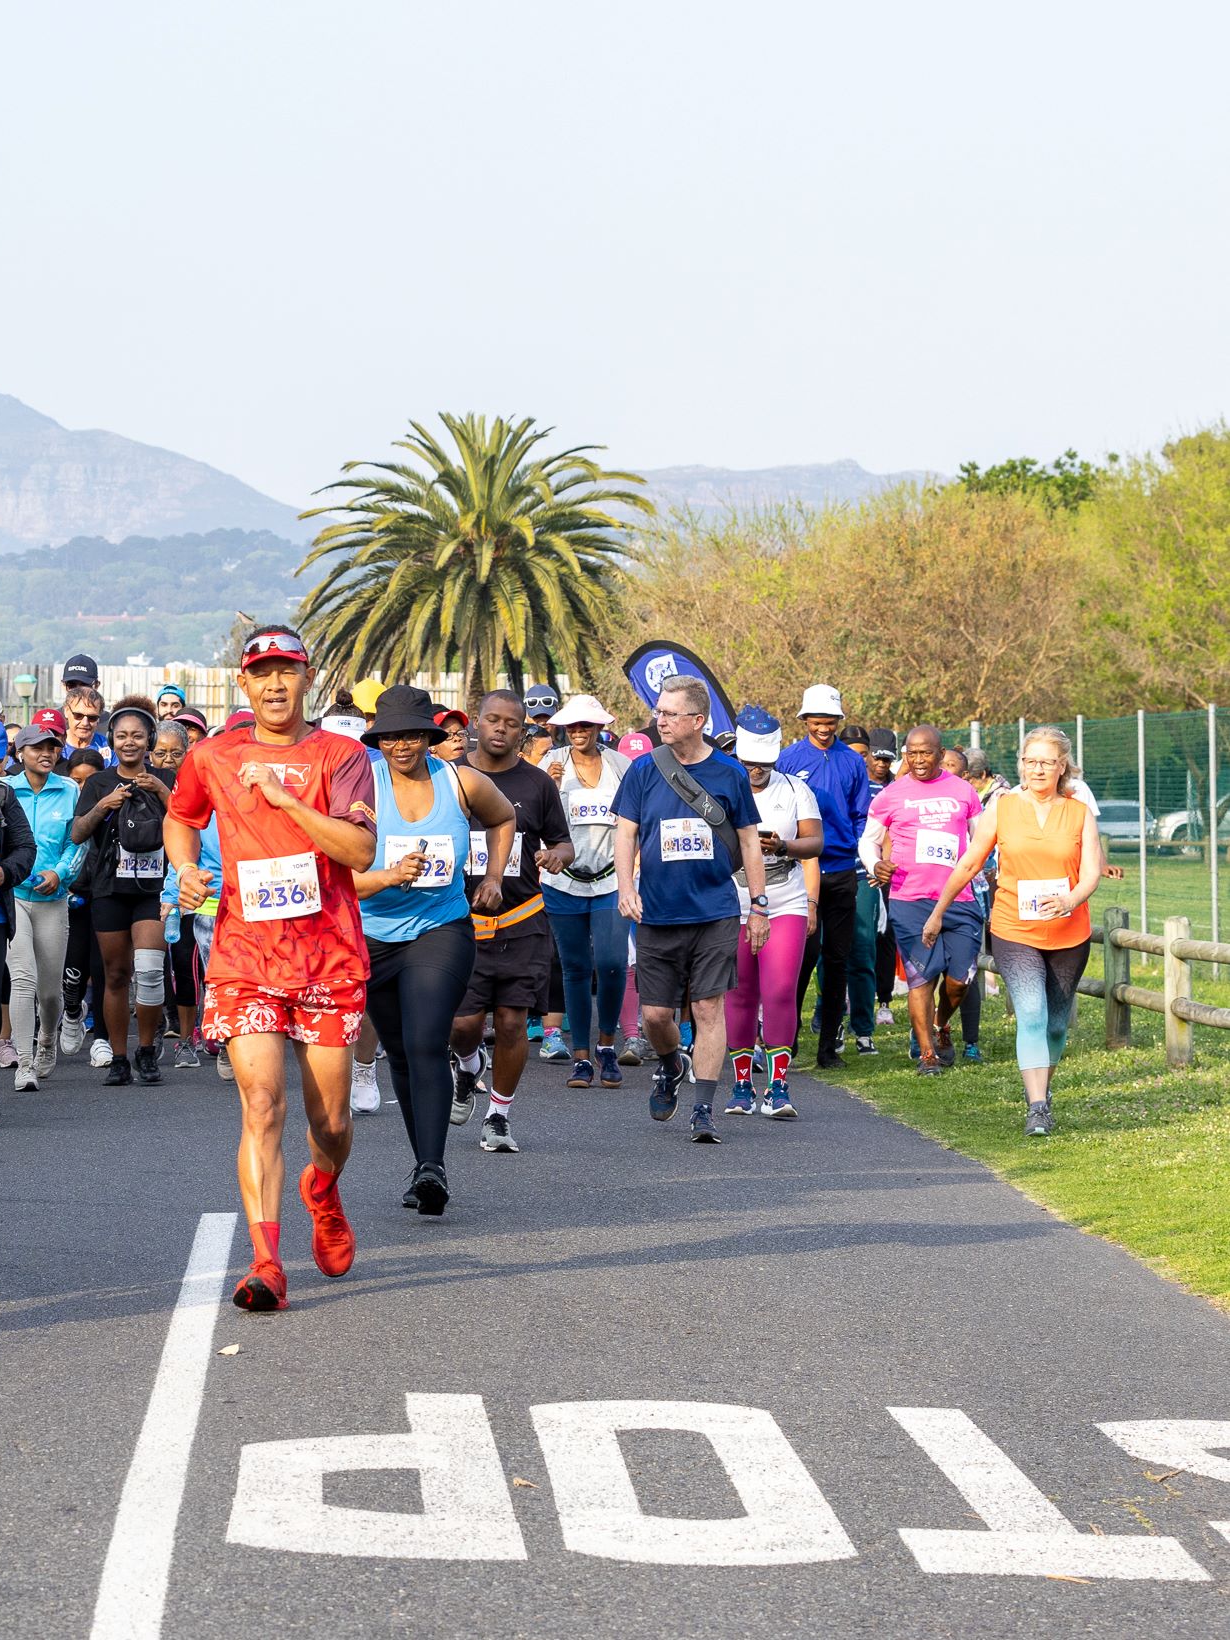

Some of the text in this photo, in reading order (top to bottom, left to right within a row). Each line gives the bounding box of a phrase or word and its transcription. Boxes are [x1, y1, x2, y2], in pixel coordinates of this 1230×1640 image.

[580, 806, 608, 817] 839
[674, 838, 702, 852] 185
[927, 846, 951, 860] 853
[124, 859, 159, 871] 1224
[258, 885, 305, 908] 236
